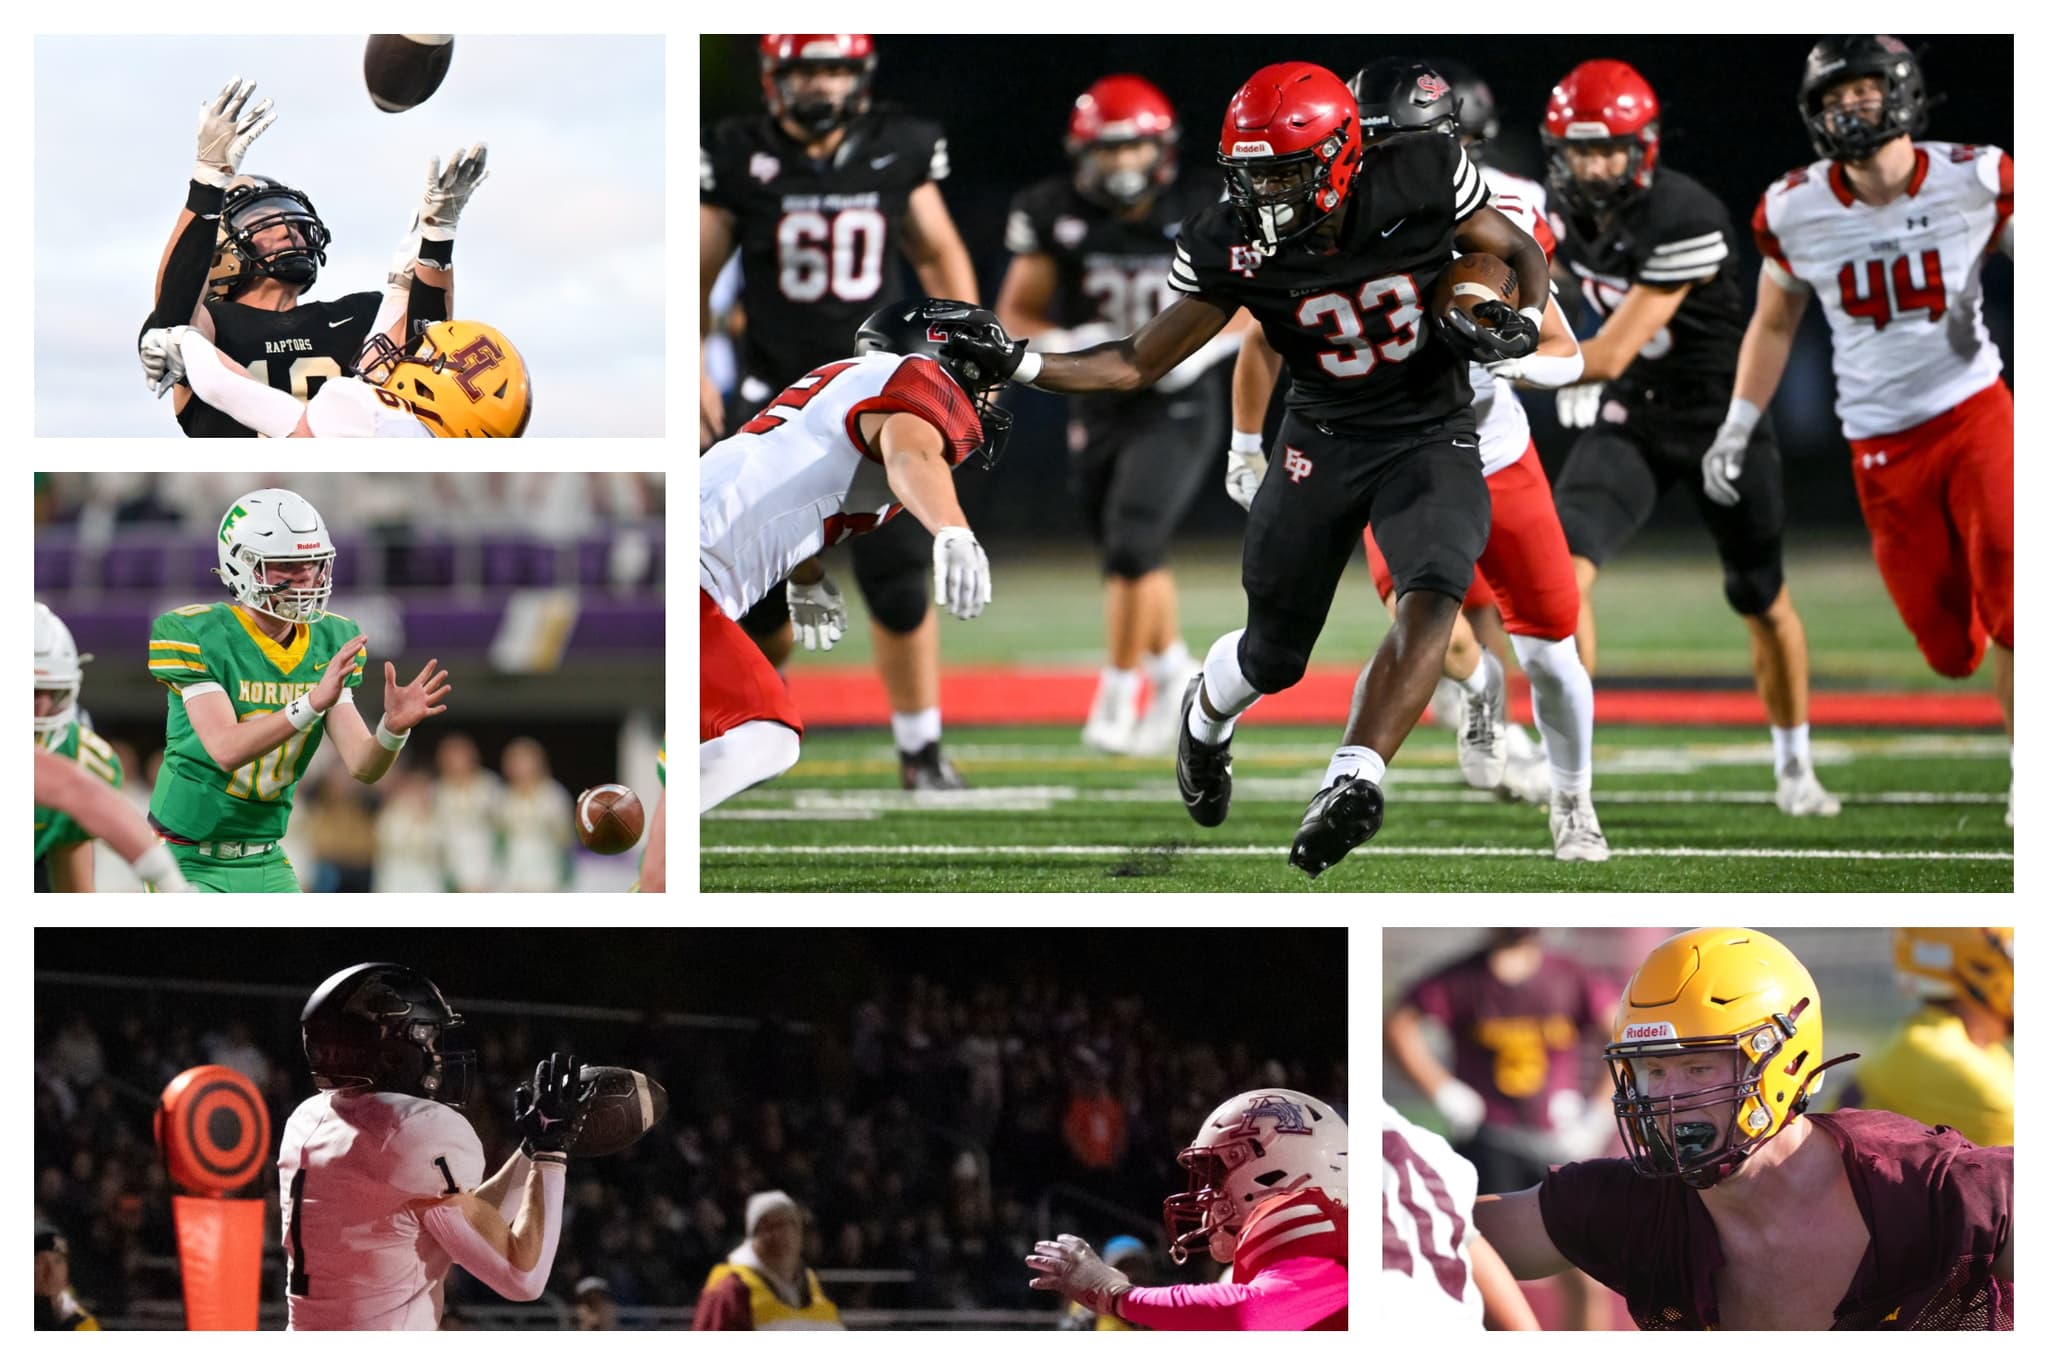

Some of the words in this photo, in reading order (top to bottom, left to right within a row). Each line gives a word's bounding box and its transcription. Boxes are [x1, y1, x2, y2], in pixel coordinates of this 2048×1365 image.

[776, 208, 887, 302] 60
[1837, 248, 1948, 332] 44
[265, 338, 313, 354] RAPTORS
[1296, 272, 1424, 378] 33
[1283, 444, 1314, 485] EP
[1626, 1024, 1668, 1039] Riddell
[431, 1155, 460, 1195] 1
[289, 1167, 311, 1297] 1
